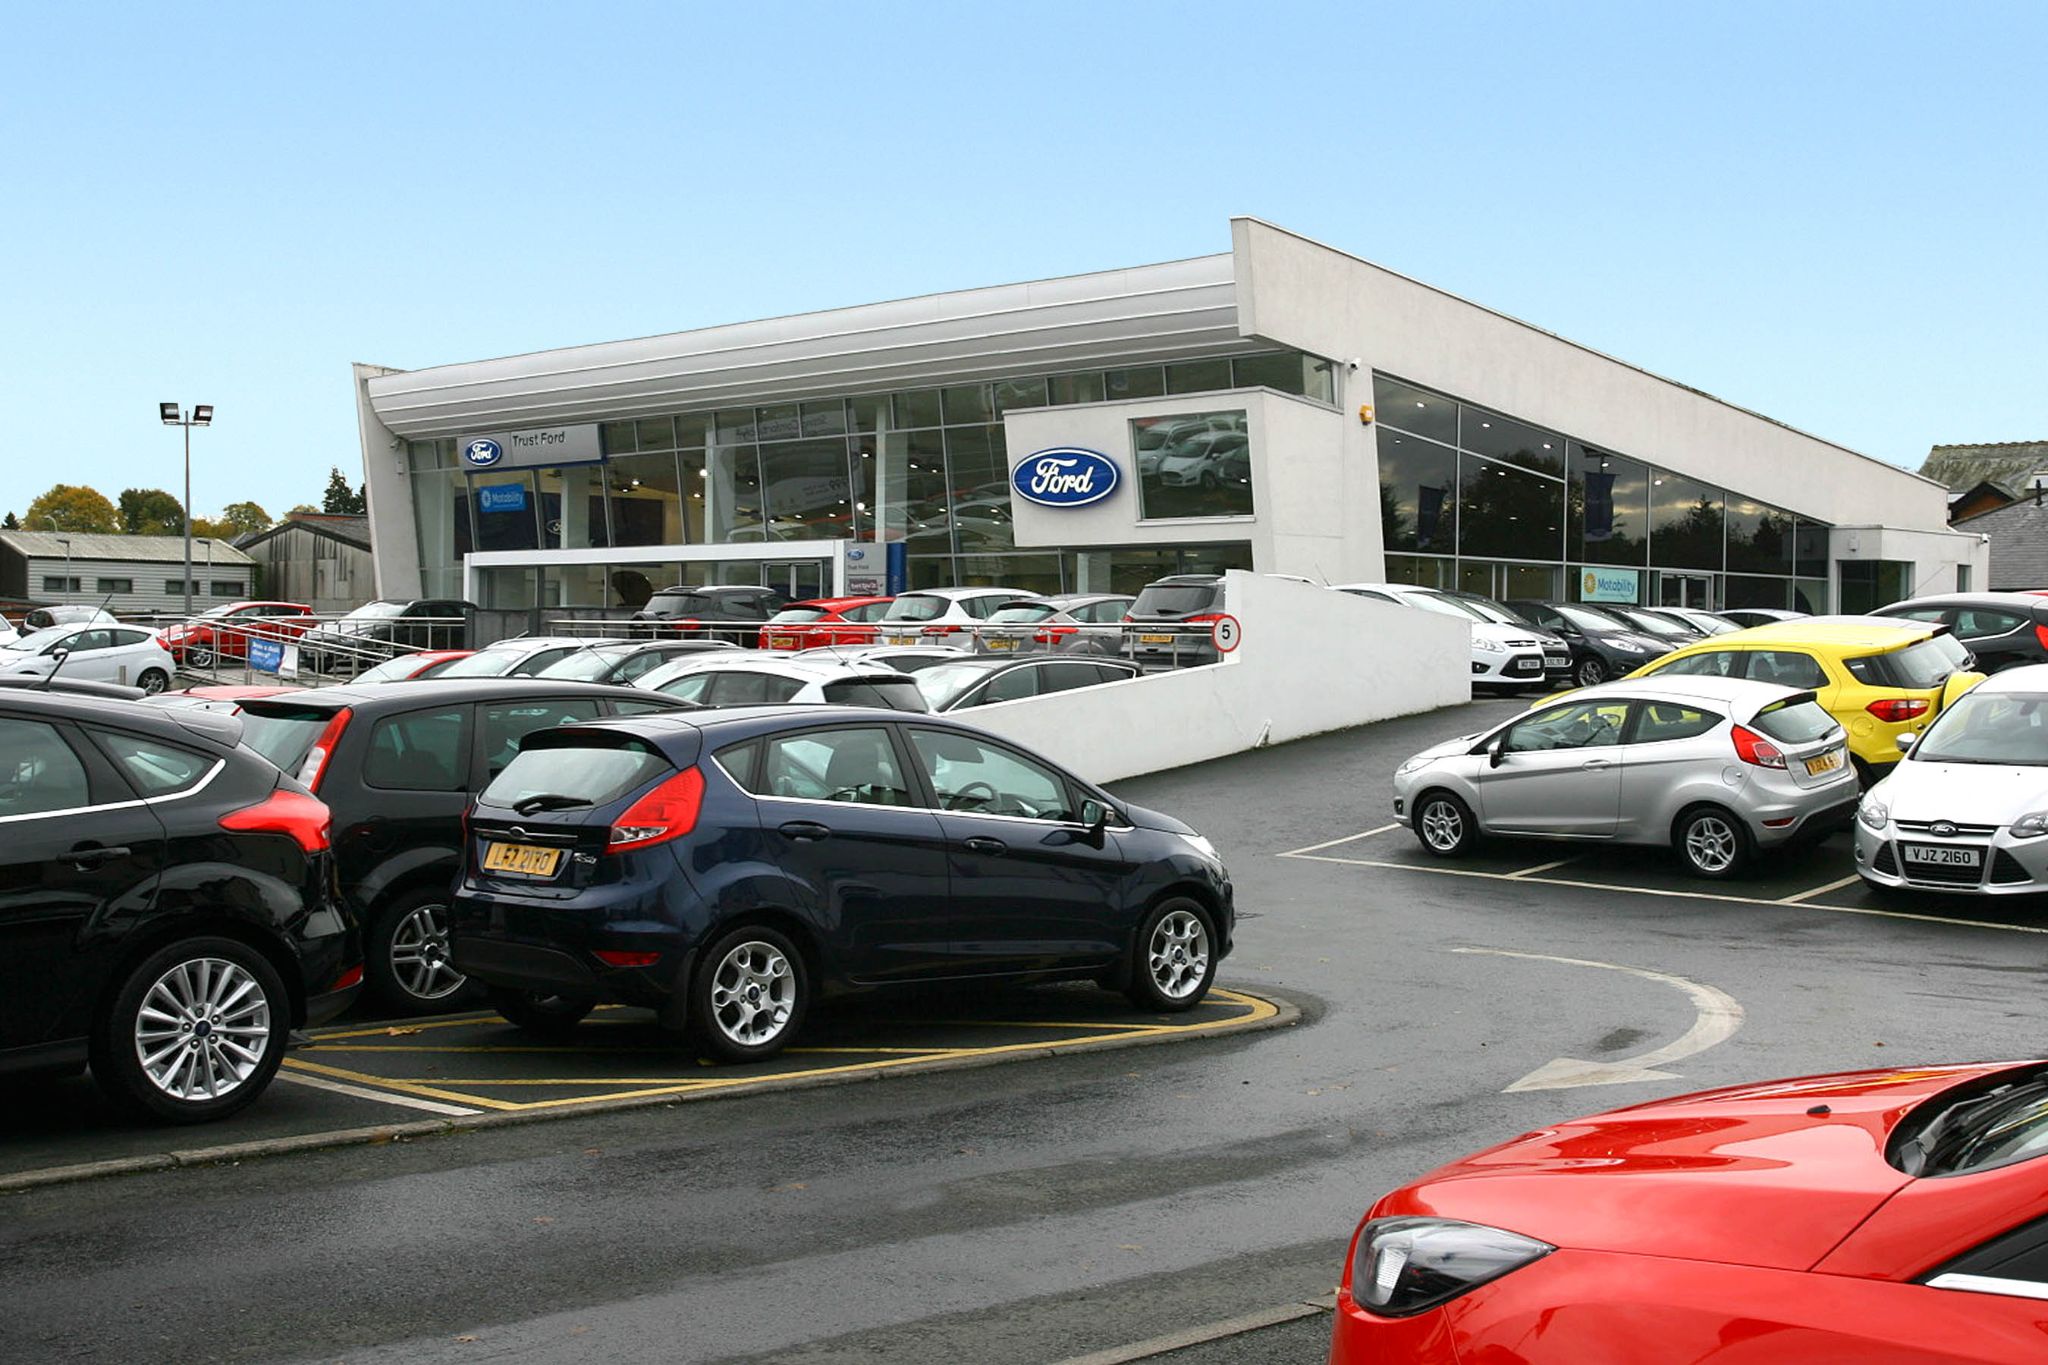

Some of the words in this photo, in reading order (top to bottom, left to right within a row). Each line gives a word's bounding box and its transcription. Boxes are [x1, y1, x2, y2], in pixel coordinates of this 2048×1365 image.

[512, 434, 539, 447] Trust
[540, 431, 565, 445] Ford
[471, 443, 493, 461] Ford
[1031, 458, 1094, 494] Ford
[1598, 578, 1635, 597] Motability
[1222, 624, 1231, 640] 5
[1913, 847, 1938, 862] VJZ
[1941, 850, 1971, 864] 2160
